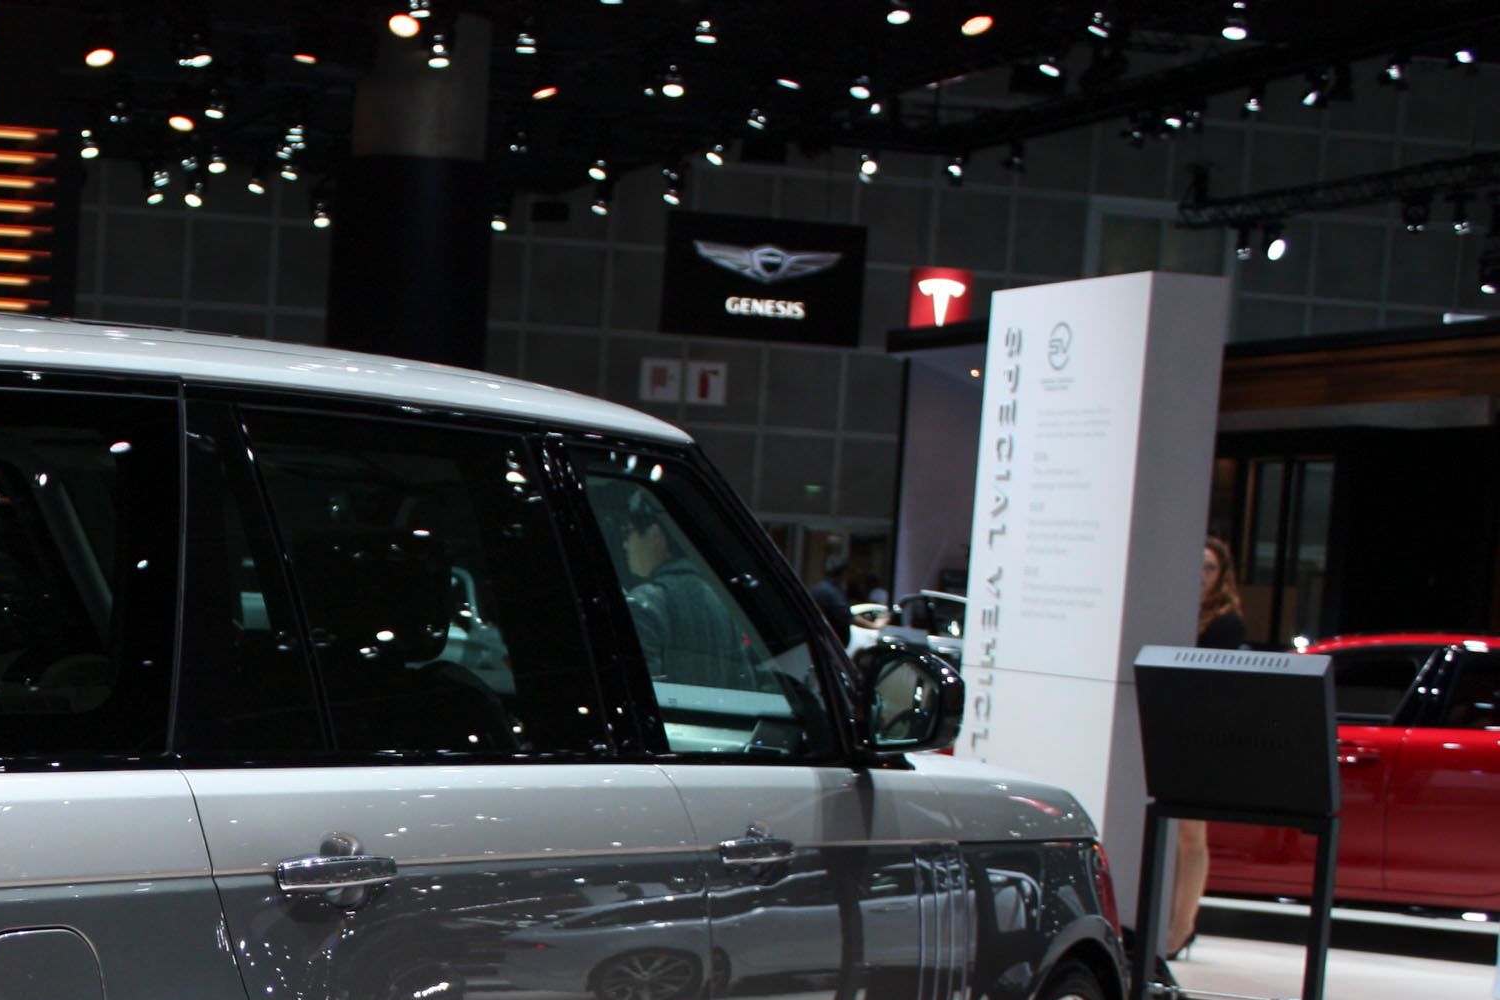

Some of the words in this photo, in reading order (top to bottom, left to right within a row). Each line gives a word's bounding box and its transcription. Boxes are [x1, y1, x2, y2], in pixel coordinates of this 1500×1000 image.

[725, 296, 805, 318] GENESIS
[988, 328, 1022, 548] SPECIAL
[970, 567, 1003, 764] VEHICL
